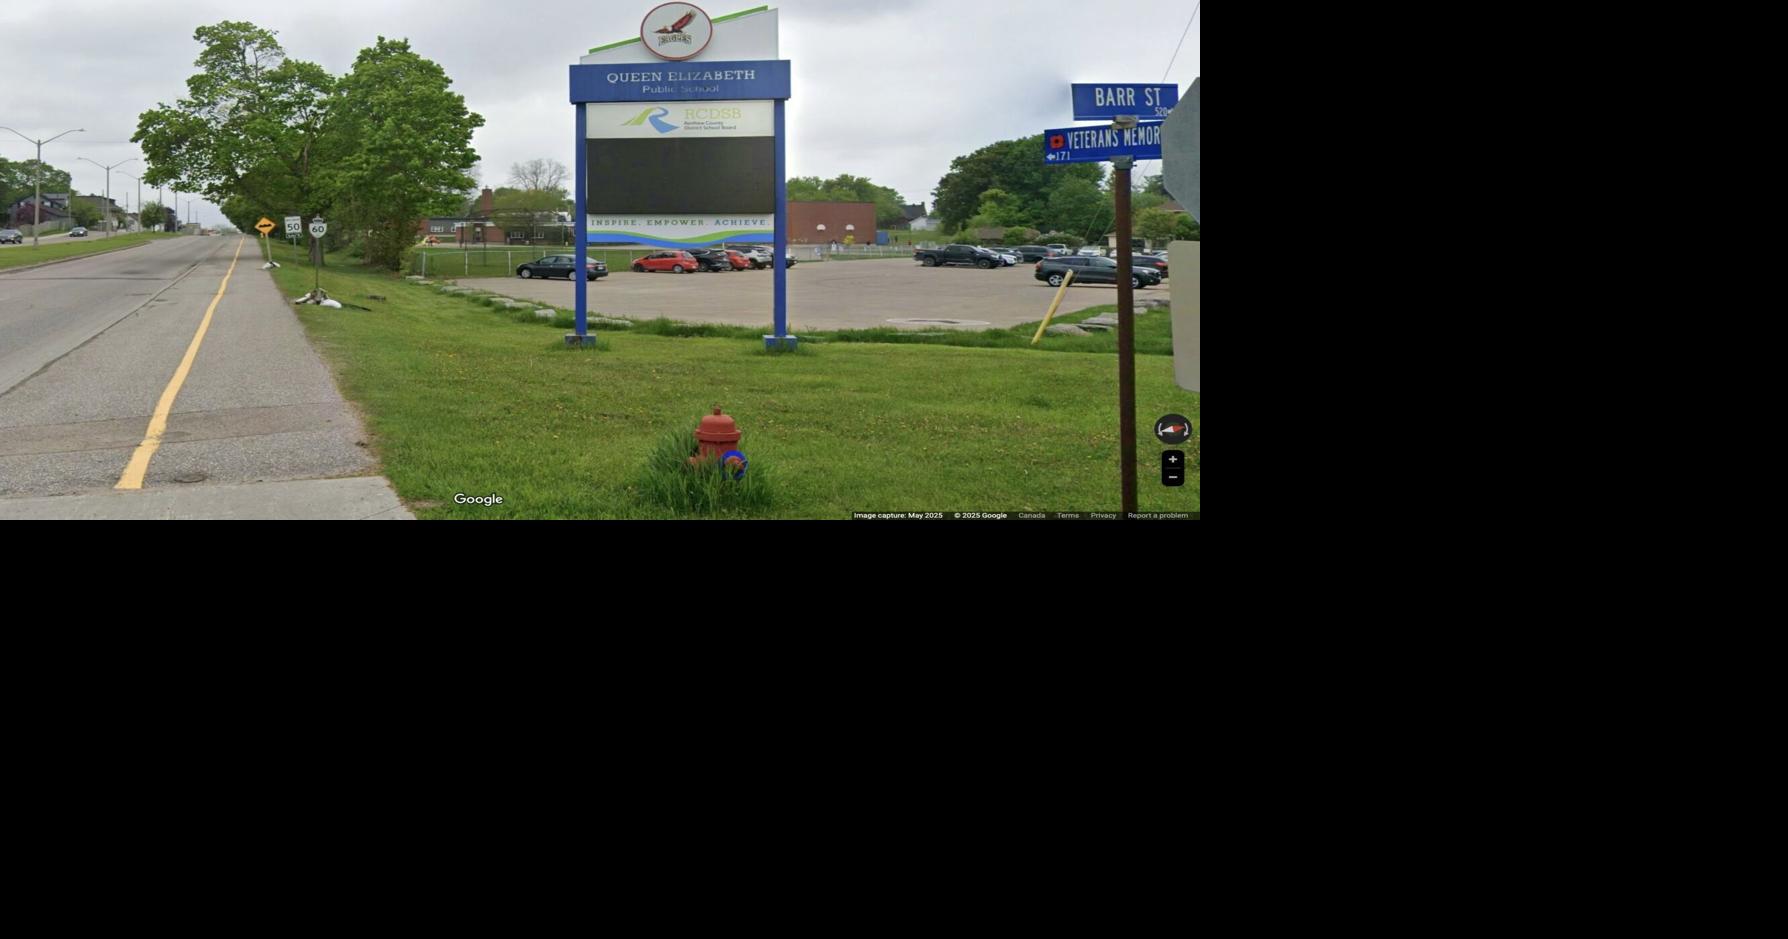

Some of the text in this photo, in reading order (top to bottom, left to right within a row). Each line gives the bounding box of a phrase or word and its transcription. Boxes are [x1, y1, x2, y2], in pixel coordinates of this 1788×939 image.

[606, 69, 756, 84] QUEEN ELIZABETH
[642, 84, 719, 94] Public School
[1095, 87, 1161, 107] BARR ST
[684, 107, 741, 120] RCDSB
[1155, 107, 1168, 117] 520
[1067, 129, 1119, 149] VETERANS
[1056, 151, 1071, 161] 171
[288, 223, 299, 231] 50
